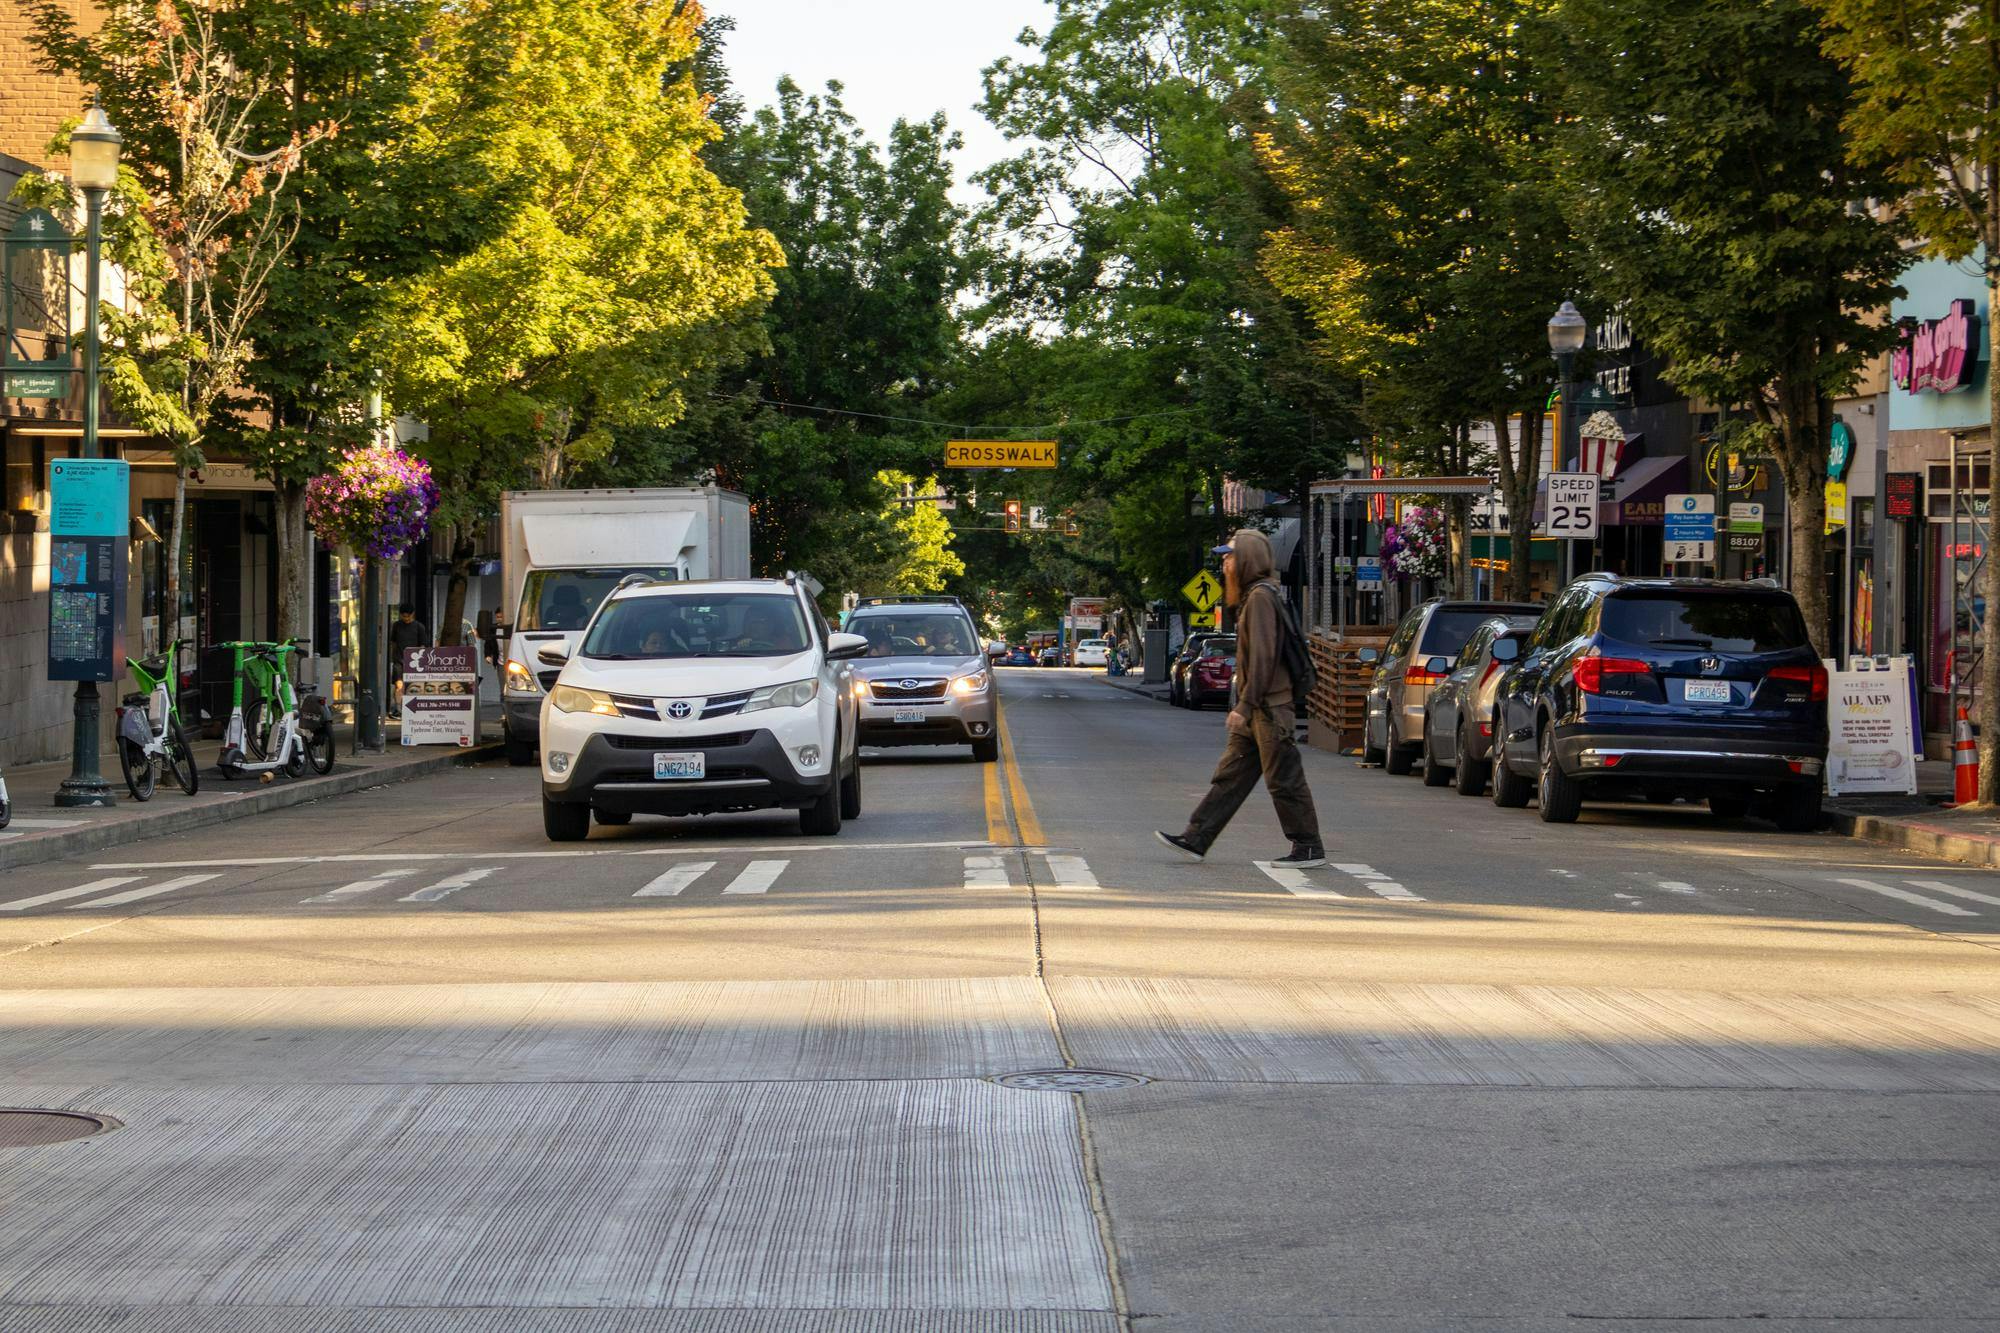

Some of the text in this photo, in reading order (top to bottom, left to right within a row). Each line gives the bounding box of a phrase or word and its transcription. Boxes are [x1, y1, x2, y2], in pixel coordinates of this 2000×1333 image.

[947, 447, 1055, 461] CROSSWALK
[1551, 479, 1595, 490] SPEED
[1555, 492, 1589, 503] LIMIT
[1624, 502, 1665, 515] EARL
[1552, 505, 1592, 530] 25
[1730, 537, 1760, 546] 88107
[427, 649, 466, 666] Shanti
[1842, 694, 1892, 706] ALL NEW
[657, 761, 701, 775] CNG2194
